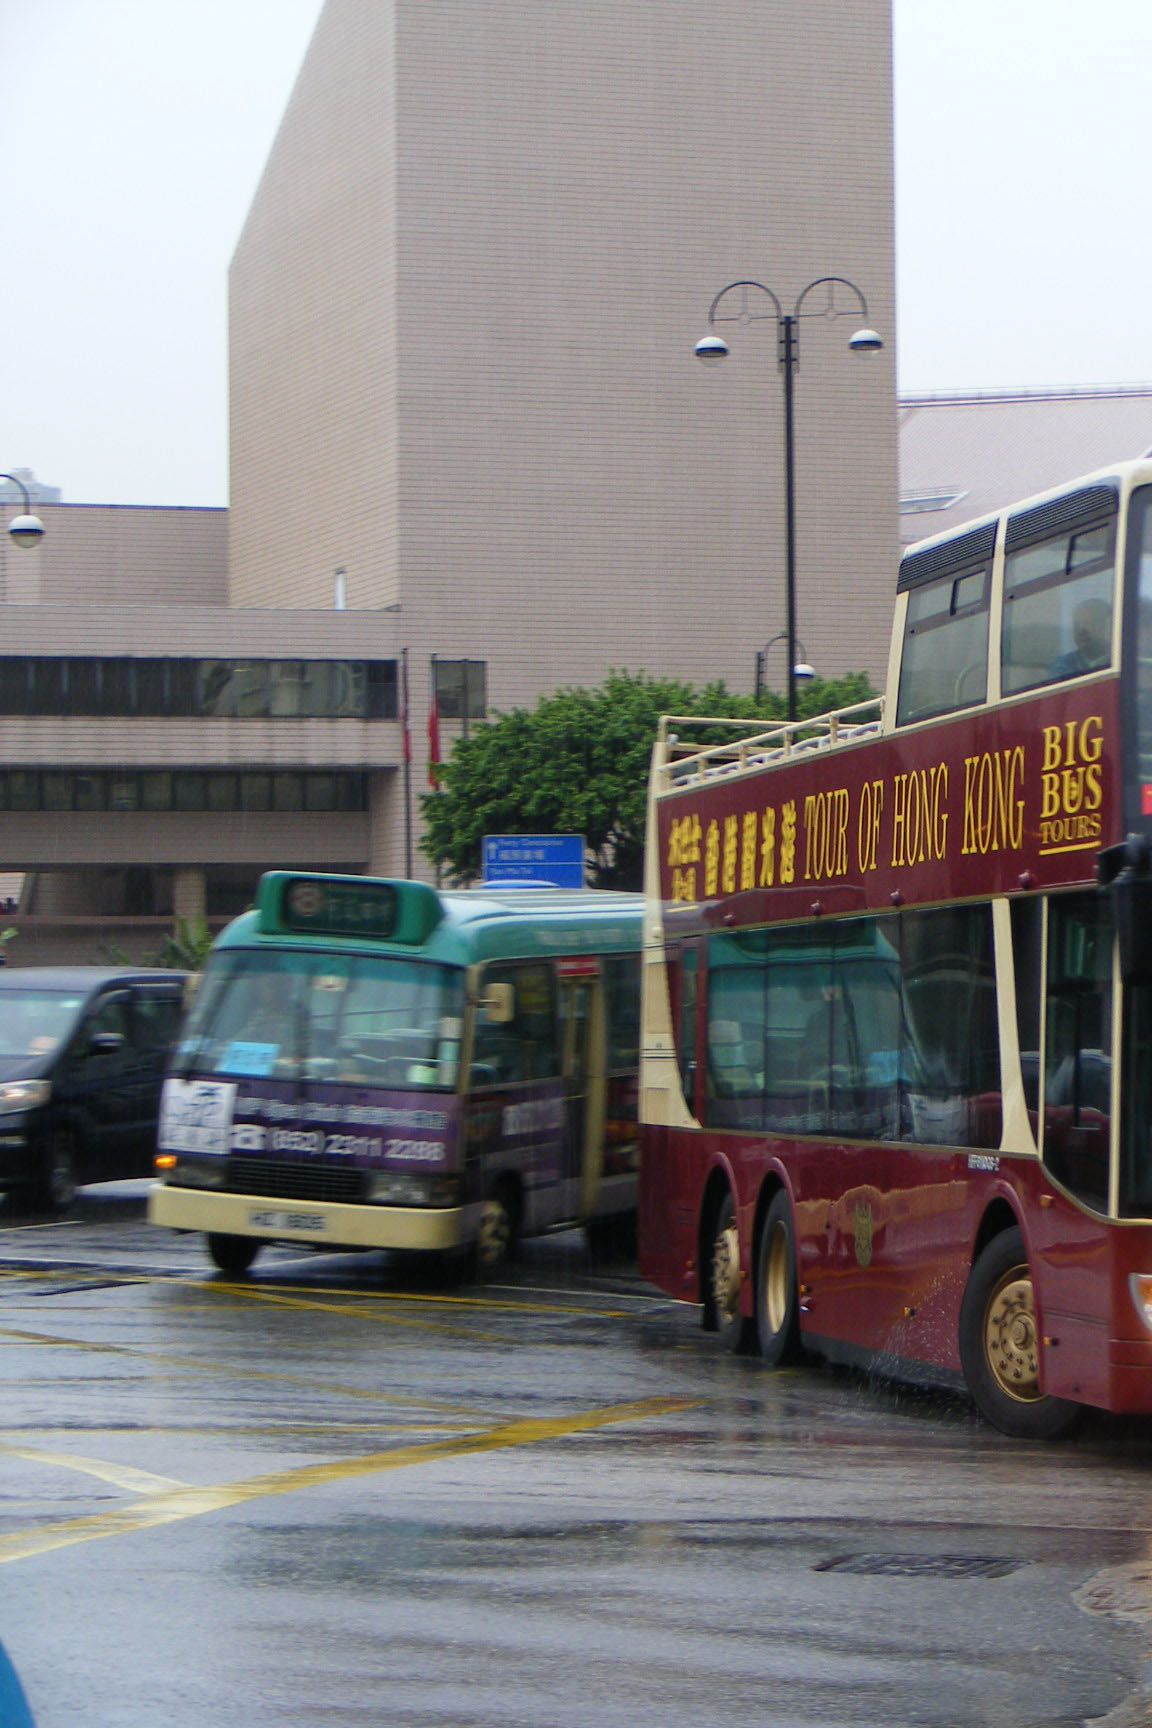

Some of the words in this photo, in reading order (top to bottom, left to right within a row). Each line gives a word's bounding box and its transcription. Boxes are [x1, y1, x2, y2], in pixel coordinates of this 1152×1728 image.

[1041, 716, 1104, 771] BIG
[803, 788, 849, 880] TOUR
[857, 780, 885, 874] OF
[891, 762, 949, 868] HONG
[961, 746, 1026, 855] KONG
[1040, 764, 1102, 818] BUS
[1040, 813, 1101, 844] TOURS
